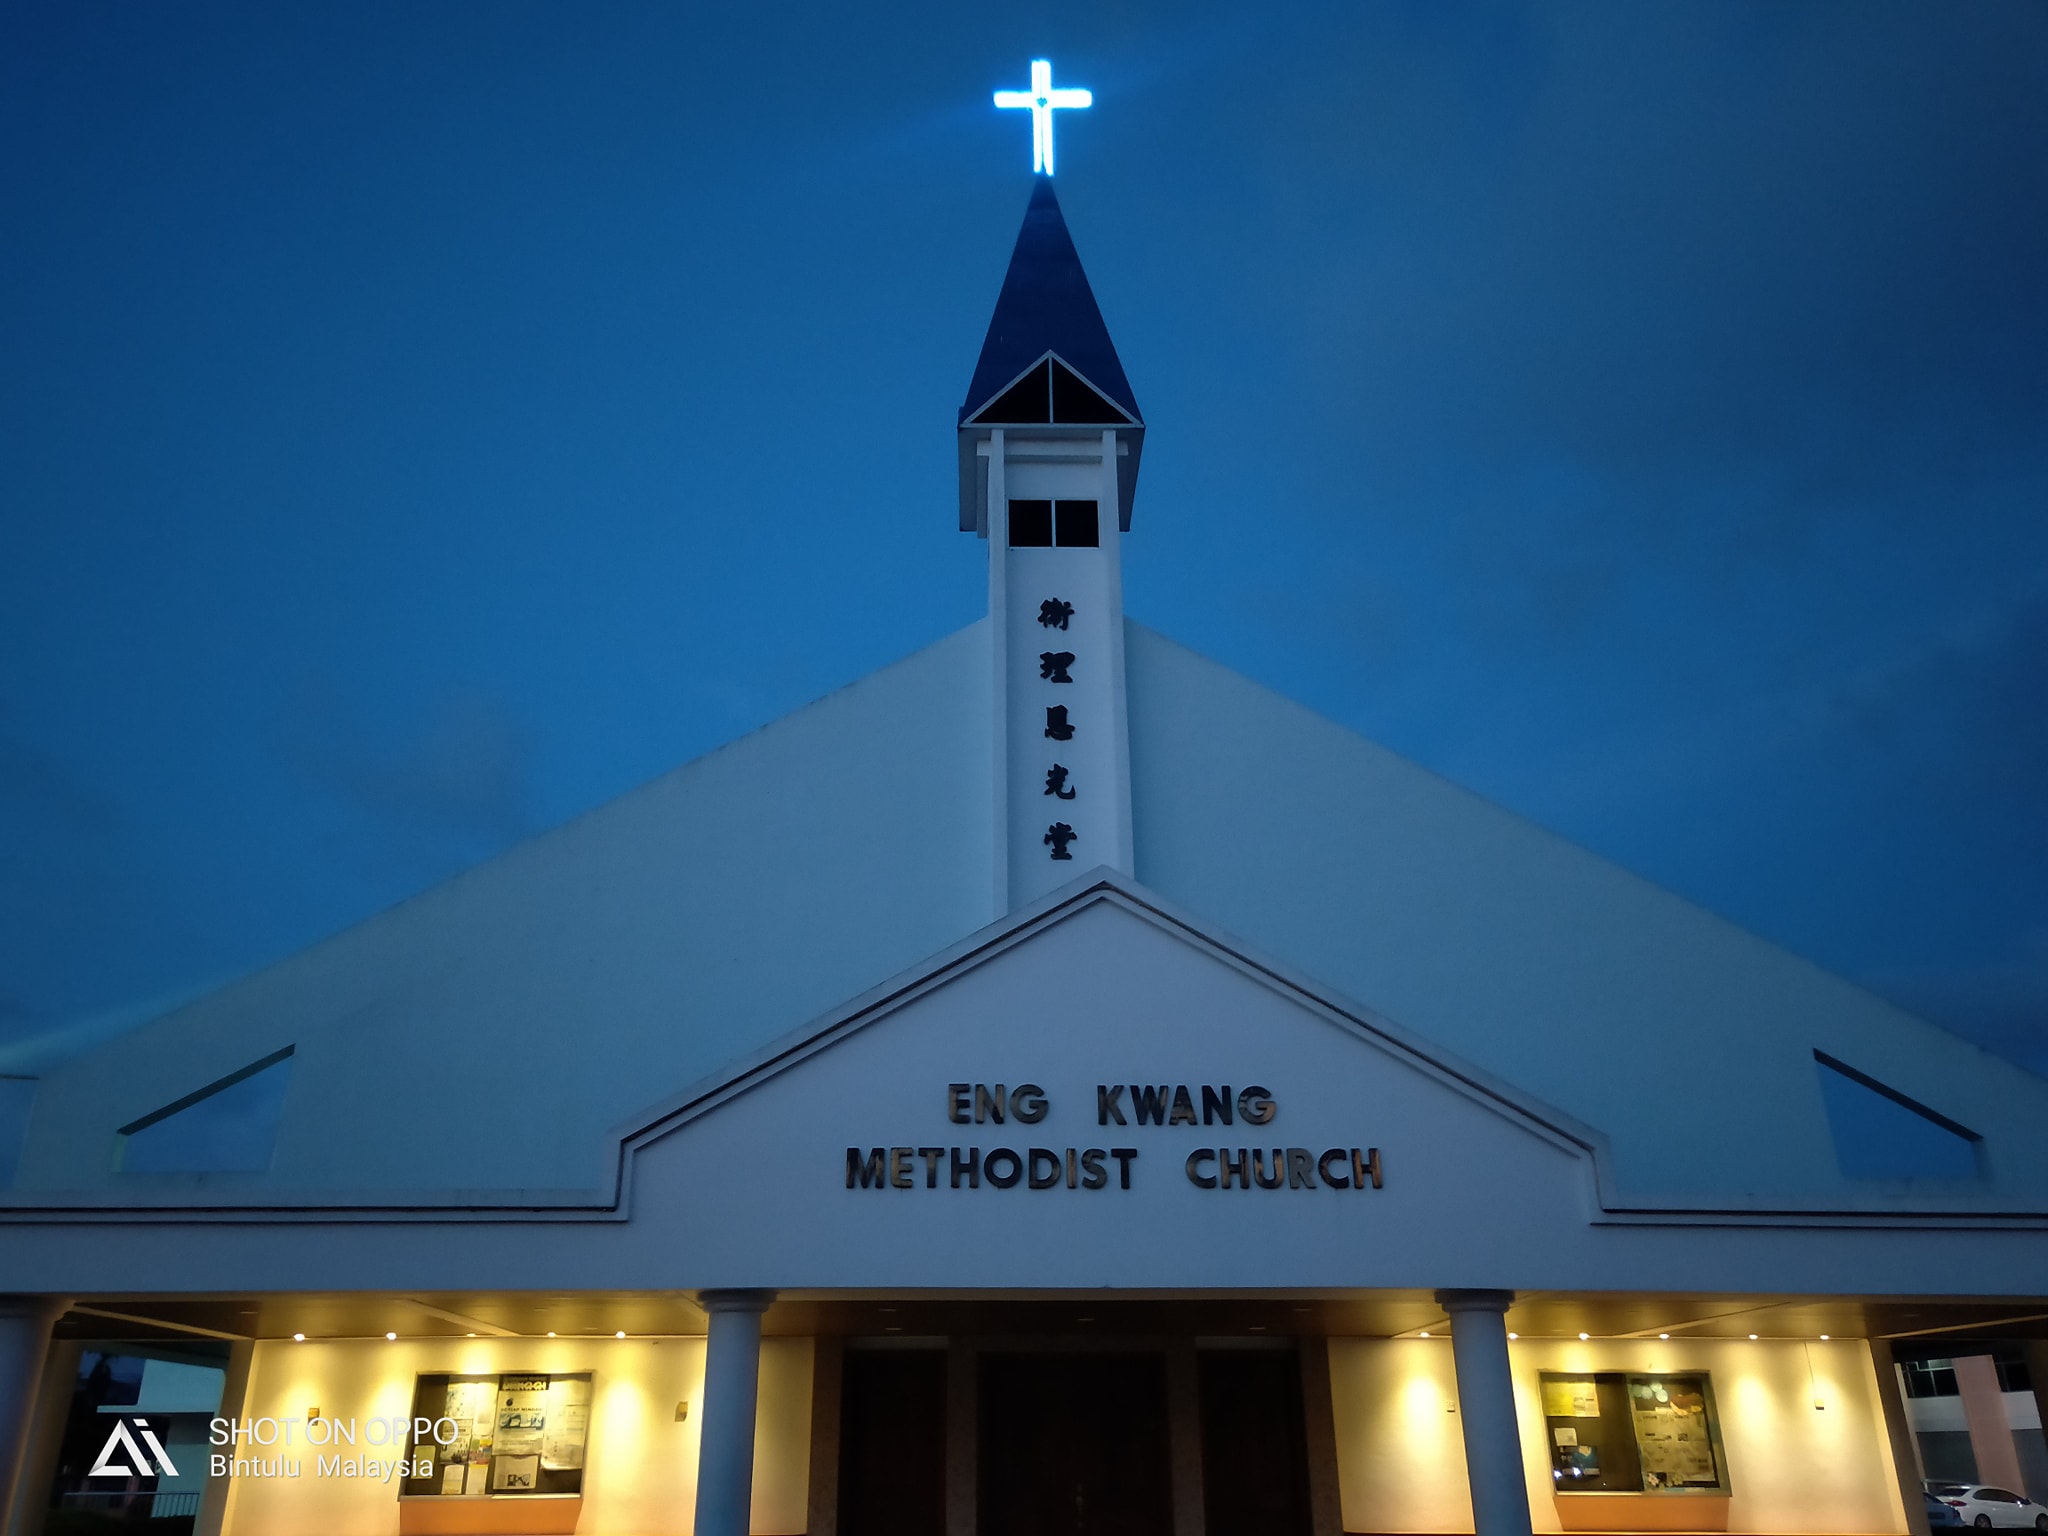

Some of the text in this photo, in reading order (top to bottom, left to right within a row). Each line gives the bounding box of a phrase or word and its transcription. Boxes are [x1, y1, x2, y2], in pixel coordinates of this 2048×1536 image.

[948, 1083, 1276, 1126] ENG KWANG
[845, 1147, 1382, 1190] METHODIST CHURCH
